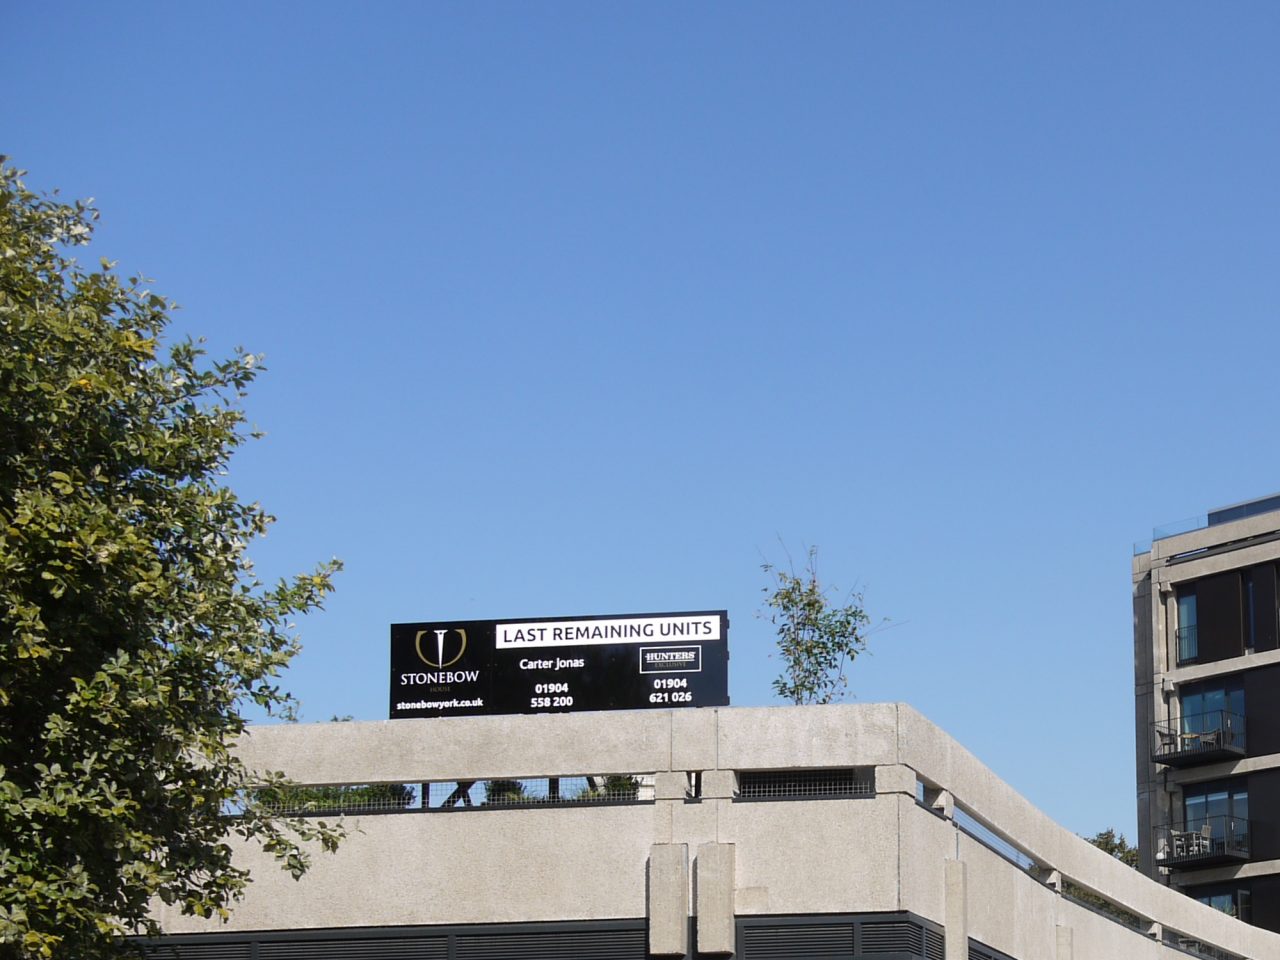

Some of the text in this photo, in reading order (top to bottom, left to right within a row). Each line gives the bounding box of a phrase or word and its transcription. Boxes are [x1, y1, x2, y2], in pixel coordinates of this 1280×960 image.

[503, 621, 712, 643] LAST REMAINING UNITS
[519, 657, 585, 671] Carter Jonas
[400, 670, 480, 686] STONEBOW
[653, 678, 687, 689] 01904
[534, 682, 569, 694] 01904
[530, 696, 574, 708] 558 200
[649, 691, 692, 703] 621 026
[396, 697, 484, 710] stonebowyork.co.uk
